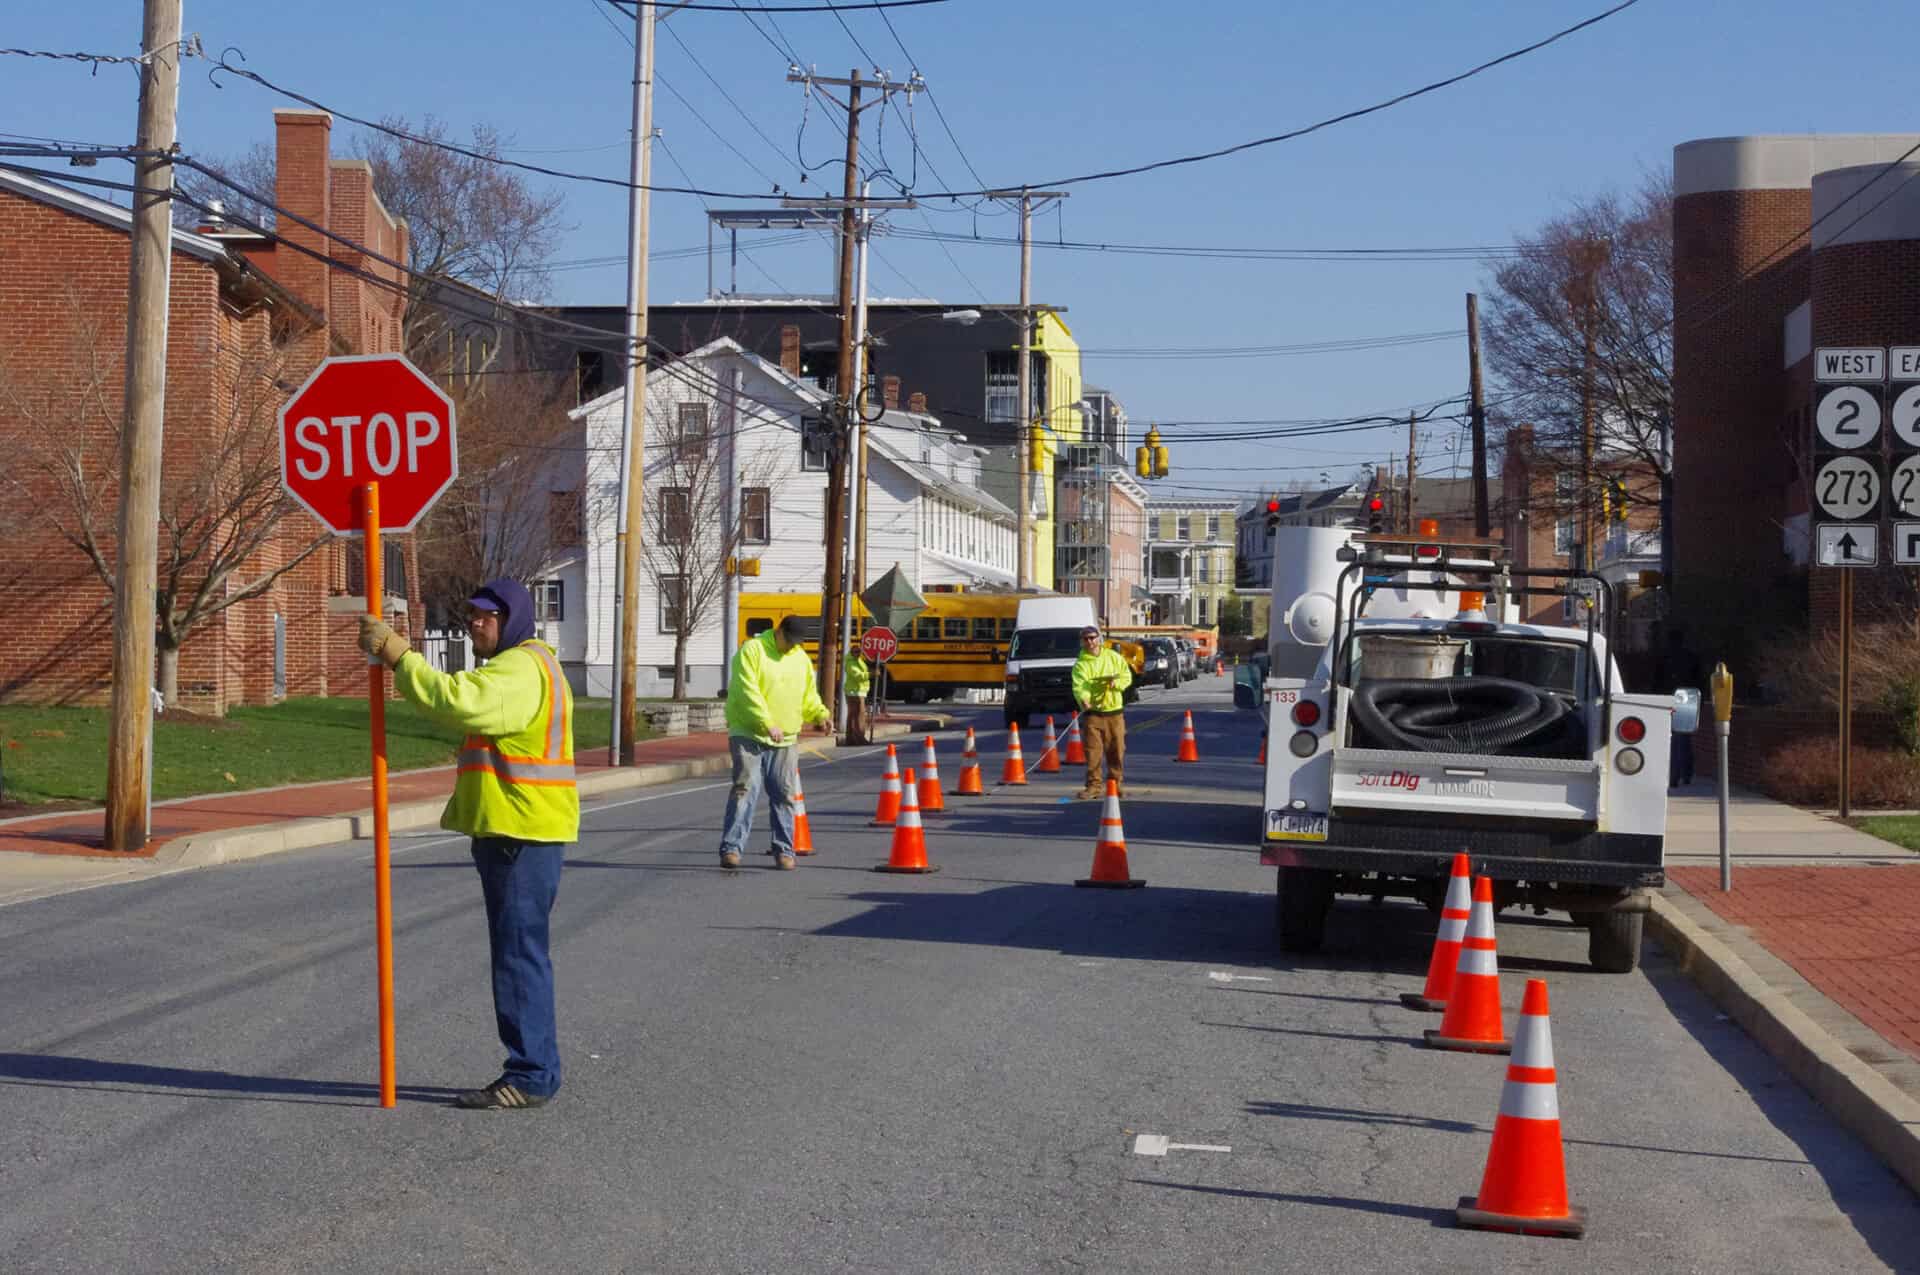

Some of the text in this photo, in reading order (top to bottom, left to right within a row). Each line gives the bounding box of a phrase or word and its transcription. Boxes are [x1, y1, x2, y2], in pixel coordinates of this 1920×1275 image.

[1825, 355, 1875, 374] WEST
[1835, 400, 1860, 435] 2
[295, 412, 440, 481] STOP
[1823, 470, 1873, 505] 273
[864, 637, 895, 651] STOP
[1275, 691, 1297, 703] 133
